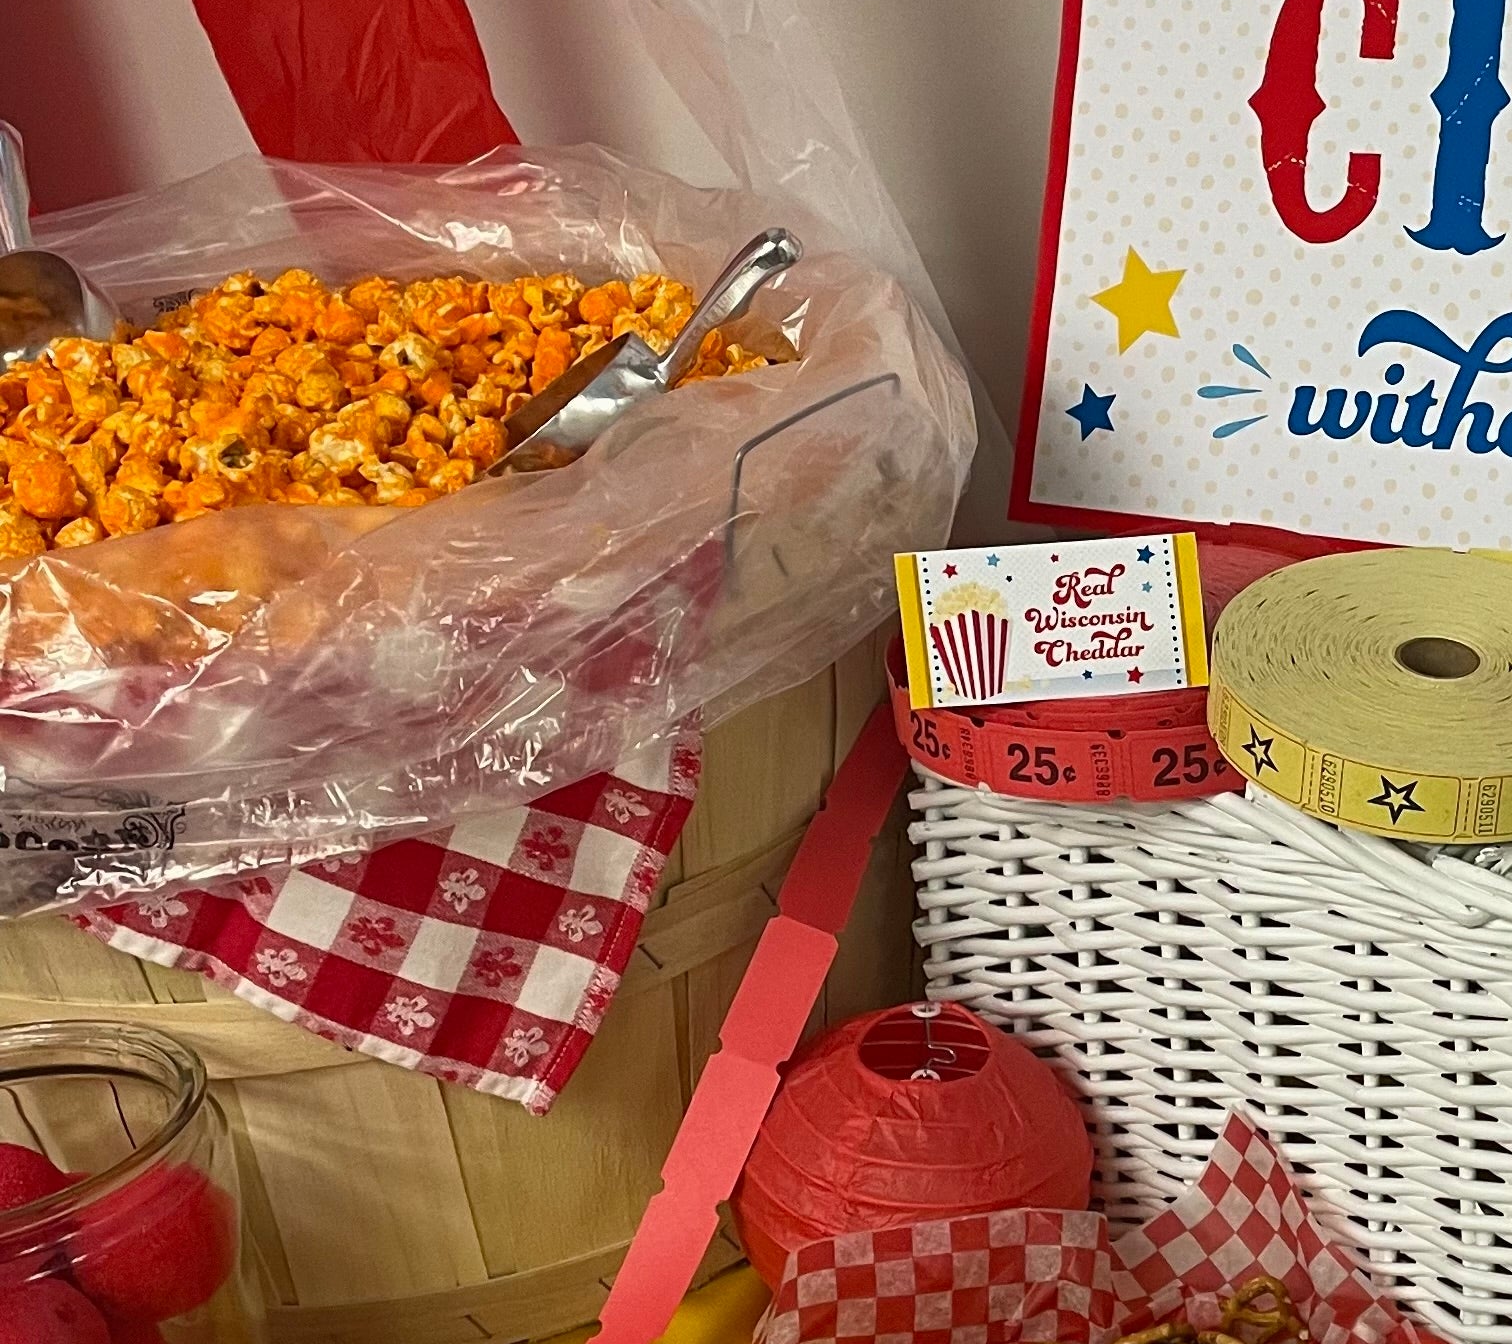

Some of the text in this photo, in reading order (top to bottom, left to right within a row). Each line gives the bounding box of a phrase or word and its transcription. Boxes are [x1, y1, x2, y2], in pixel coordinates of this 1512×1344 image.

[1052, 563, 1126, 609] Real
[1024, 606, 1155, 634] Wisconsin
[1034, 627, 1146, 667] Cheddar
[910, 710, 951, 761] 25¢
[1007, 742, 1077, 786] 25¢
[1319, 757, 1337, 814] 6290510
[1478, 784, 1497, 834] 6290511
